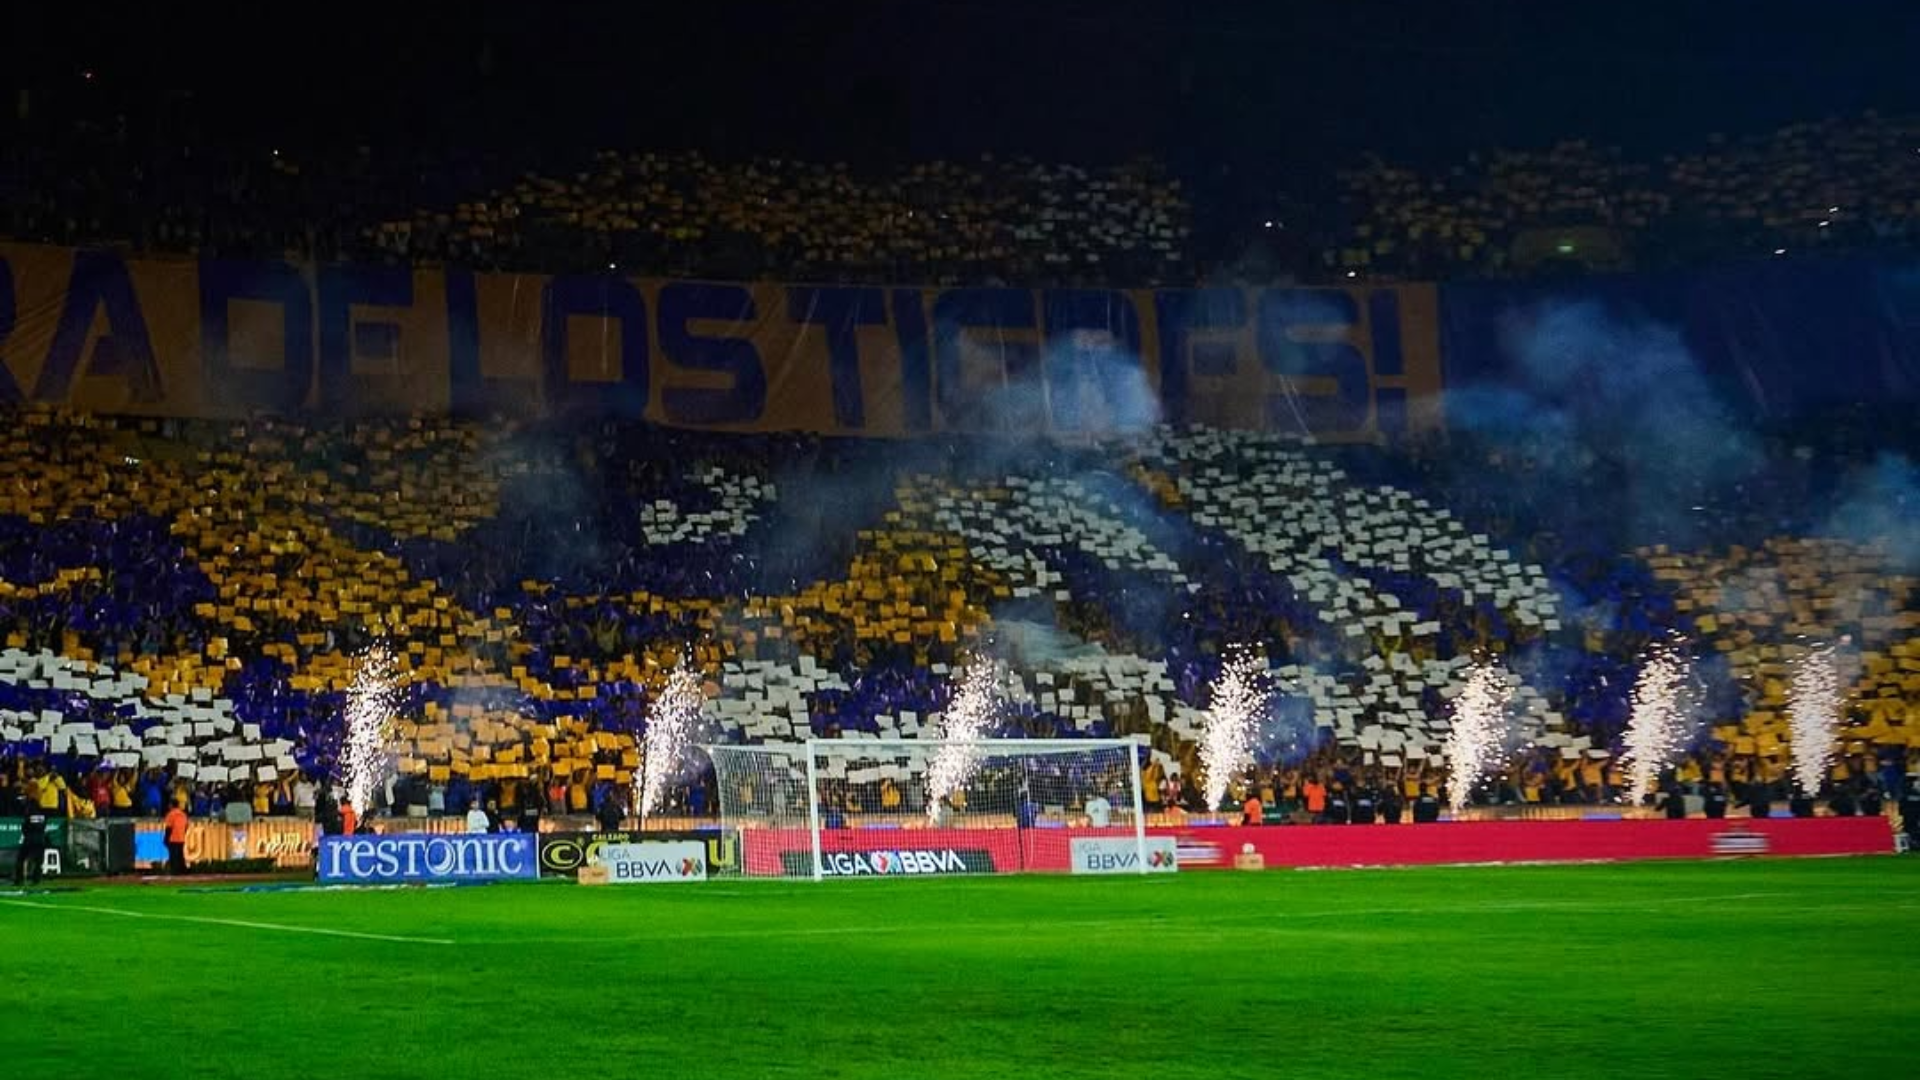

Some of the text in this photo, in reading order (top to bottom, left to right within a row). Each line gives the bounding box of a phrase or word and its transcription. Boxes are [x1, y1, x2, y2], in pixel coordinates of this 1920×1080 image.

[200, 257, 413, 417] DE
[445, 266, 767, 423] LOS
[616, 859, 672, 879] BBVA
[820, 848, 967, 875] LIGA BBVA
[1087, 853, 1140, 870] BBVA
